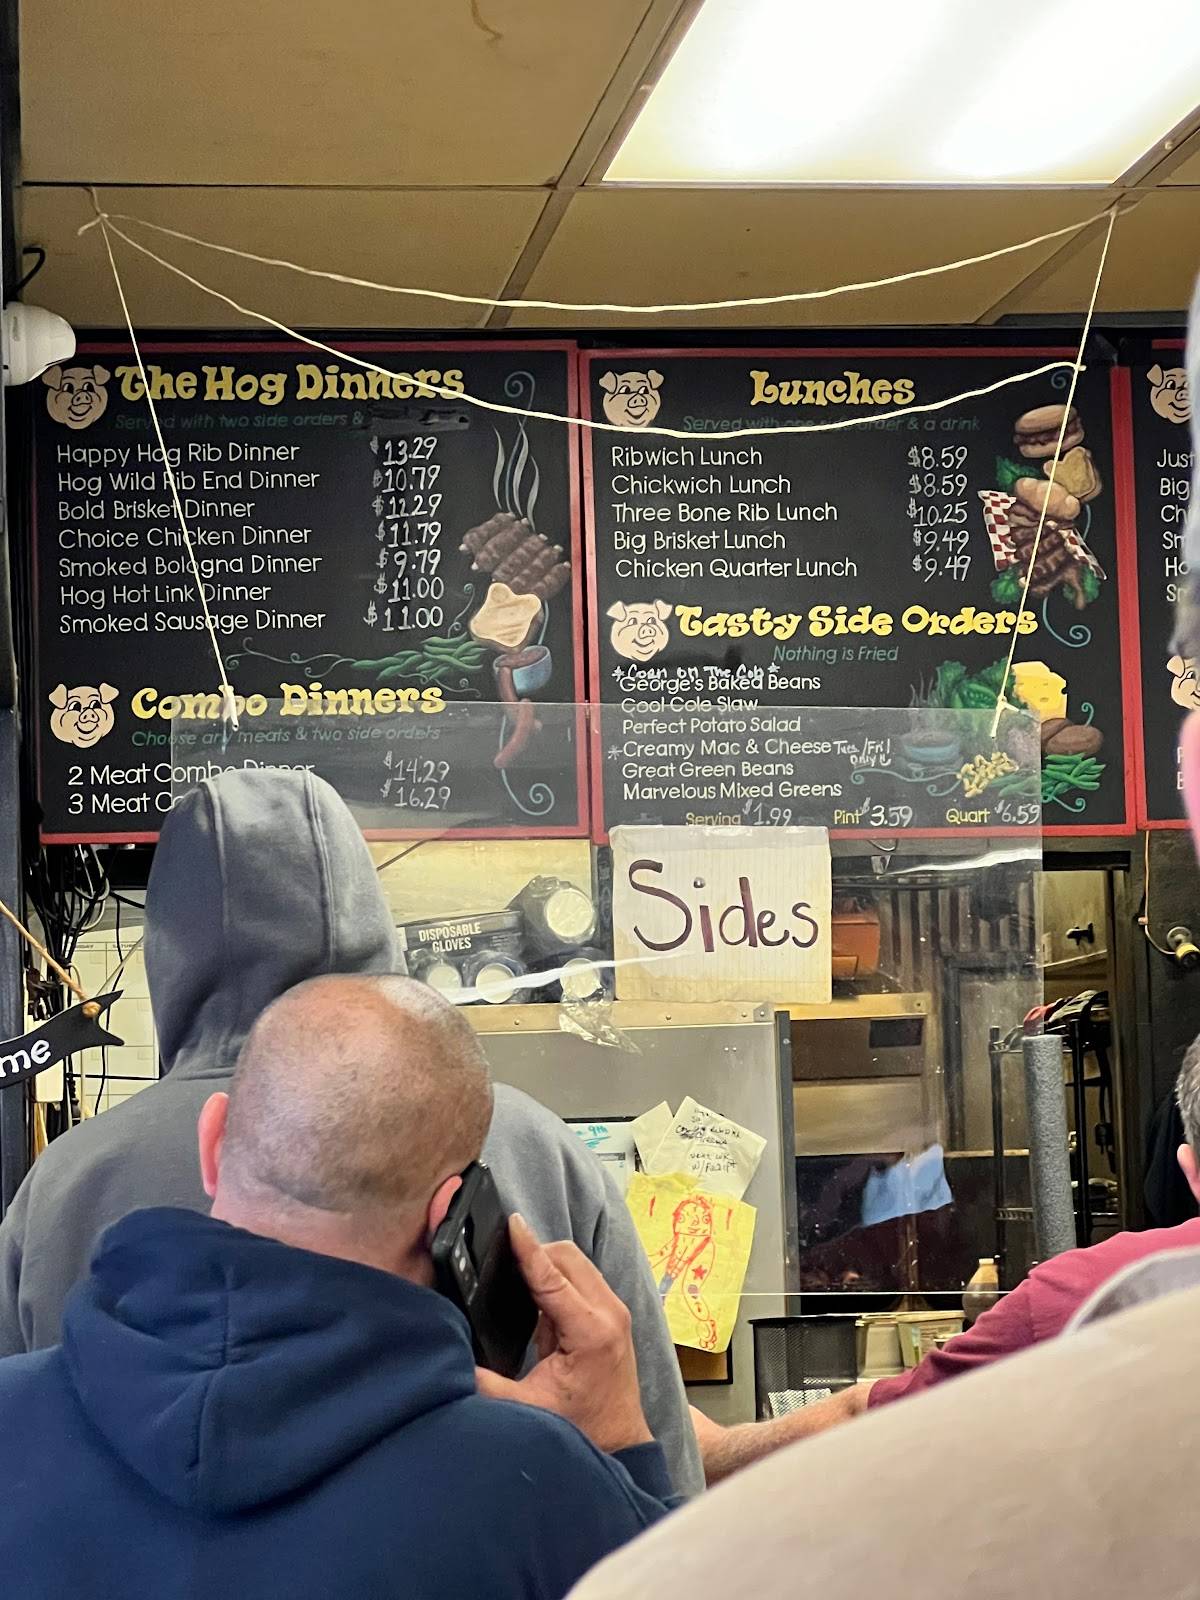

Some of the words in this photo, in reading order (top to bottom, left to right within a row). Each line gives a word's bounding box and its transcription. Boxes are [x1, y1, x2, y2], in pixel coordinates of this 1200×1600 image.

[114, 364, 197, 401] The
[202, 365, 288, 406] Hog
[296, 363, 465, 401] Dinners
[750, 369, 916, 406] Lunches
[180, 414, 215, 429] with
[220, 414, 250, 428] two
[252, 412, 288, 428] side
[292, 411, 348, 427] orders
[352, 411, 365, 426] &
[683, 415, 742, 432] Served
[907, 417, 920, 432] &
[924, 419, 935, 431] a
[940, 415, 981, 432] drink
[57, 444, 131, 468] Happy
[137, 443, 181, 468] Hog
[188, 442, 222, 463] Rib
[228, 442, 300, 462] Dinner
[611, 446, 695, 467] Ribwich
[700, 446, 763, 466] Lunch
[907, 445, 968, 470] $8.59
[58, 473, 102, 496] Hog
[109, 472, 155, 491] Wild
[163, 471, 196, 490] Rib
[203, 471, 242, 490] End
[249, 469, 321, 489] Dinner
[611, 474, 722, 495] Chickwich
[730, 474, 791, 495] Lunch
[908, 473, 968, 497] $8.59
[1160, 477, 1190, 500] Big
[58, 500, 105, 521] Bold
[113, 499, 179, 520] Brisket
[185, 499, 256, 519] Dinner
[611, 502, 672, 523] Three
[678, 503, 731, 523] Bone
[737, 502, 770, 522] Rib
[777, 502, 838, 522] Lunch
[906, 497, 968, 527] $10.25
[58, 528, 139, 549] Choice
[147, 527, 235, 547] Chicken
[242, 526, 312, 545] Dinner
[375, 521, 442, 548] $11.79
[613, 530, 647, 555] Big
[653, 530, 720, 551] Brisket
[724, 529, 786, 550] Lunch
[913, 528, 969, 555] $9.49
[59, 557, 147, 578] Smoked
[155, 555, 243, 578] Bologna
[251, 554, 323, 574] Dinner
[376, 548, 441, 578] $9.79
[615, 558, 703, 578] Chicken
[709, 558, 792, 579] Quarter
[796, 557, 858, 578] Lunch
[912, 554, 971, 583] $9.49
[61, 585, 105, 610] Hog
[113, 584, 150, 604] Hot
[155, 583, 195, 603] Link
[202, 582, 272, 602] Dinner
[374, 572, 444, 603] $11.00
[60, 612, 148, 634] Smoked
[154, 611, 249, 635] Sausage
[255, 609, 326, 630] Dinner
[363, 600, 444, 631] $11.00
[674, 604, 802, 641] Tasty
[808, 604, 894, 638] Side
[901, 604, 1039, 636] Orders
[773, 644, 837, 665] Nothing
[841, 646, 854, 661] is
[857, 645, 899, 661] Fried
[619, 676, 704, 694] George's
[708, 675, 763, 691] Baked
[768, 674, 821, 690] Beans
[131, 684, 268, 720] Combo
[279, 681, 447, 716] Dinners
[621, 696, 665, 714] Cool
[670, 696, 712, 714] Cole
[717, 695, 759, 713] Slaw
[131, 730, 196, 747] Choose
[238, 728, 291, 745] meats
[295, 726, 307, 741] &
[312, 728, 342, 742] two
[347, 727, 382, 741] side
[623, 718, 687, 735] Perfect
[690, 717, 747, 734] Potato
[750, 716, 801, 733] Salad
[623, 740, 695, 760] Creamy
[701, 739, 741, 757] Mac
[746, 739, 759, 755] &
[765, 738, 832, 755] Cheese
[67, 765, 84, 786] 2
[90, 762, 151, 786] Meat
[383, 750, 450, 784] $14.29
[622, 762, 676, 780] Great
[679, 761, 736, 778] Green
[741, 760, 794, 777] Beans
[380, 778, 451, 810] $16.29
[623, 782, 716, 801] Marvelous
[720, 781, 774, 799] Mixed
[778, 780, 842, 798] Greens
[68, 792, 84, 815] 3
[92, 791, 151, 814] Meat
[834, 809, 863, 825] Pint
[860, 797, 913, 827] $3.59
[946, 808, 991, 824] Quart
[994, 800, 1041, 825] $6.59
[628, 858, 819, 953] Sides
[418, 922, 482, 942] DISPOSABLE
[432, 937, 472, 953] GLOVES
